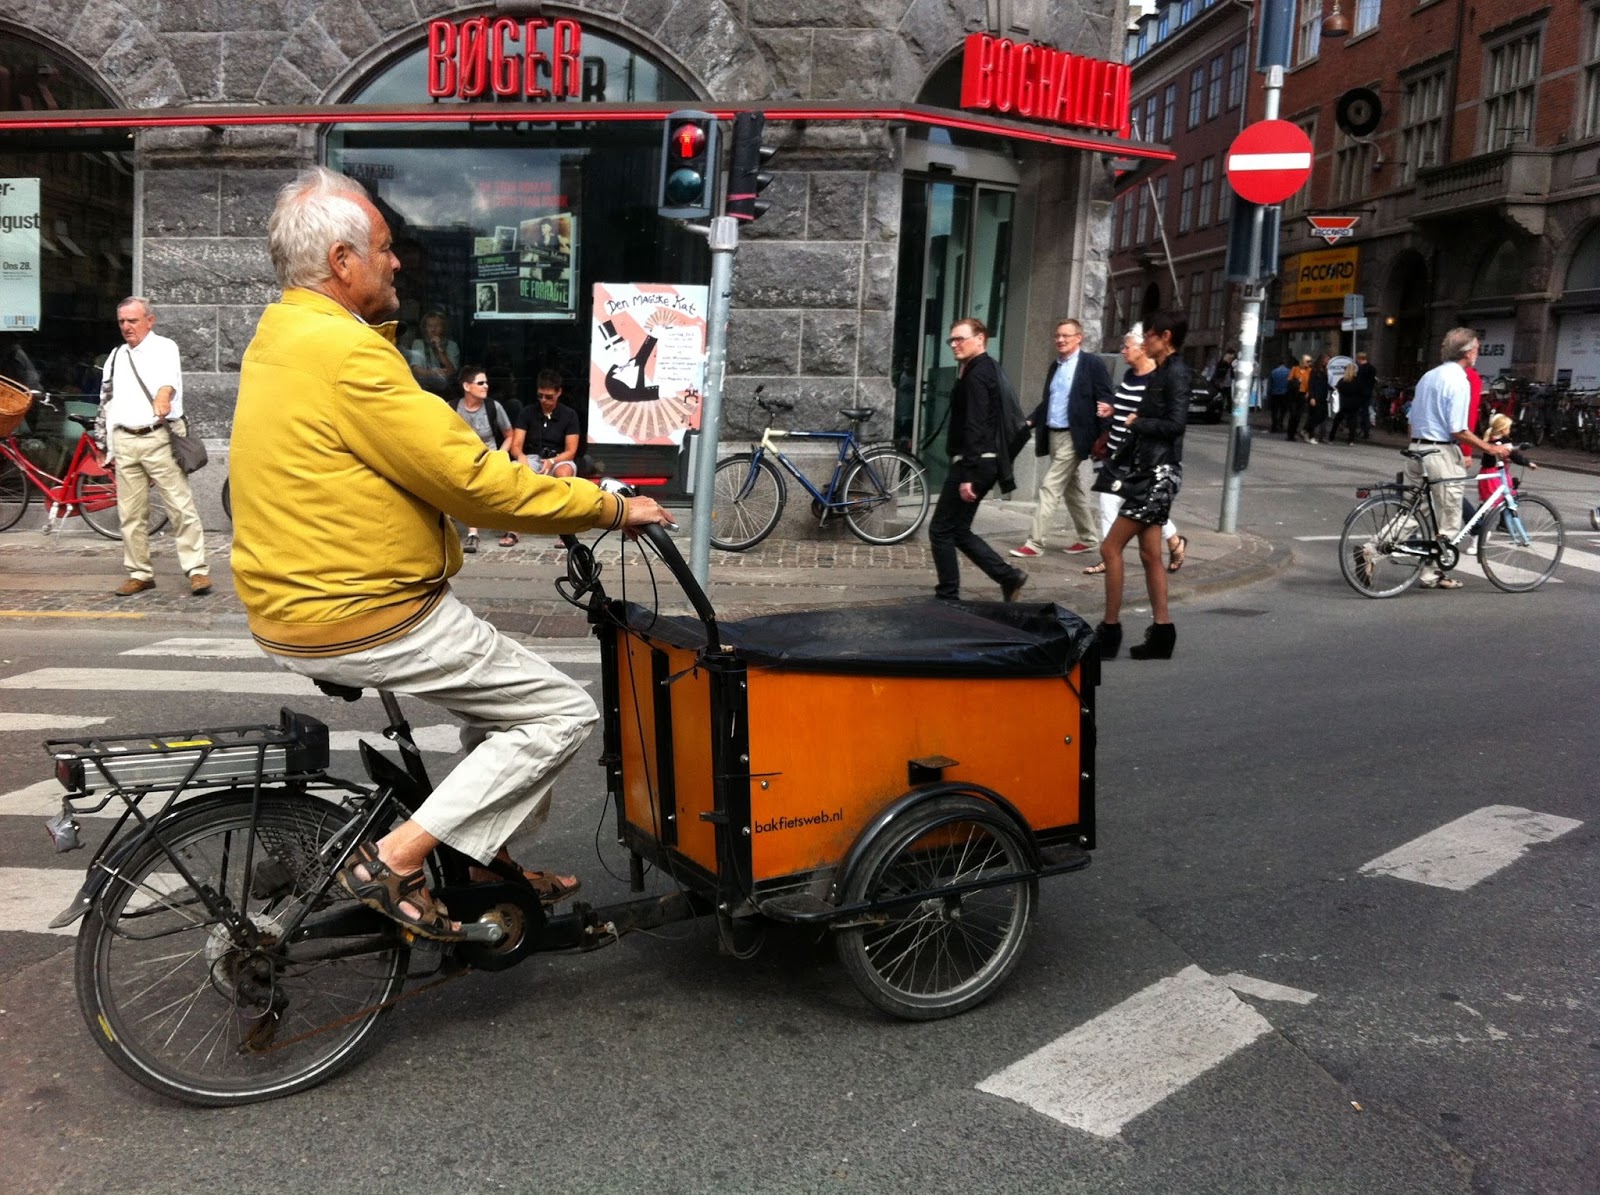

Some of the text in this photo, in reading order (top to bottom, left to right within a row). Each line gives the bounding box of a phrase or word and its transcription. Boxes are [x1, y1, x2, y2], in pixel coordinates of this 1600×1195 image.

[427, 15, 583, 99] BØGER
[0, 213, 40, 233] gust
[1315, 229, 1350, 237] ACCORD
[1301, 261, 1354, 281] ACCORD
[606, 299, 629, 315] Den
[672, 295, 696, 315] Kat
[755, 808, 843, 834] bakfietsweb.nl
